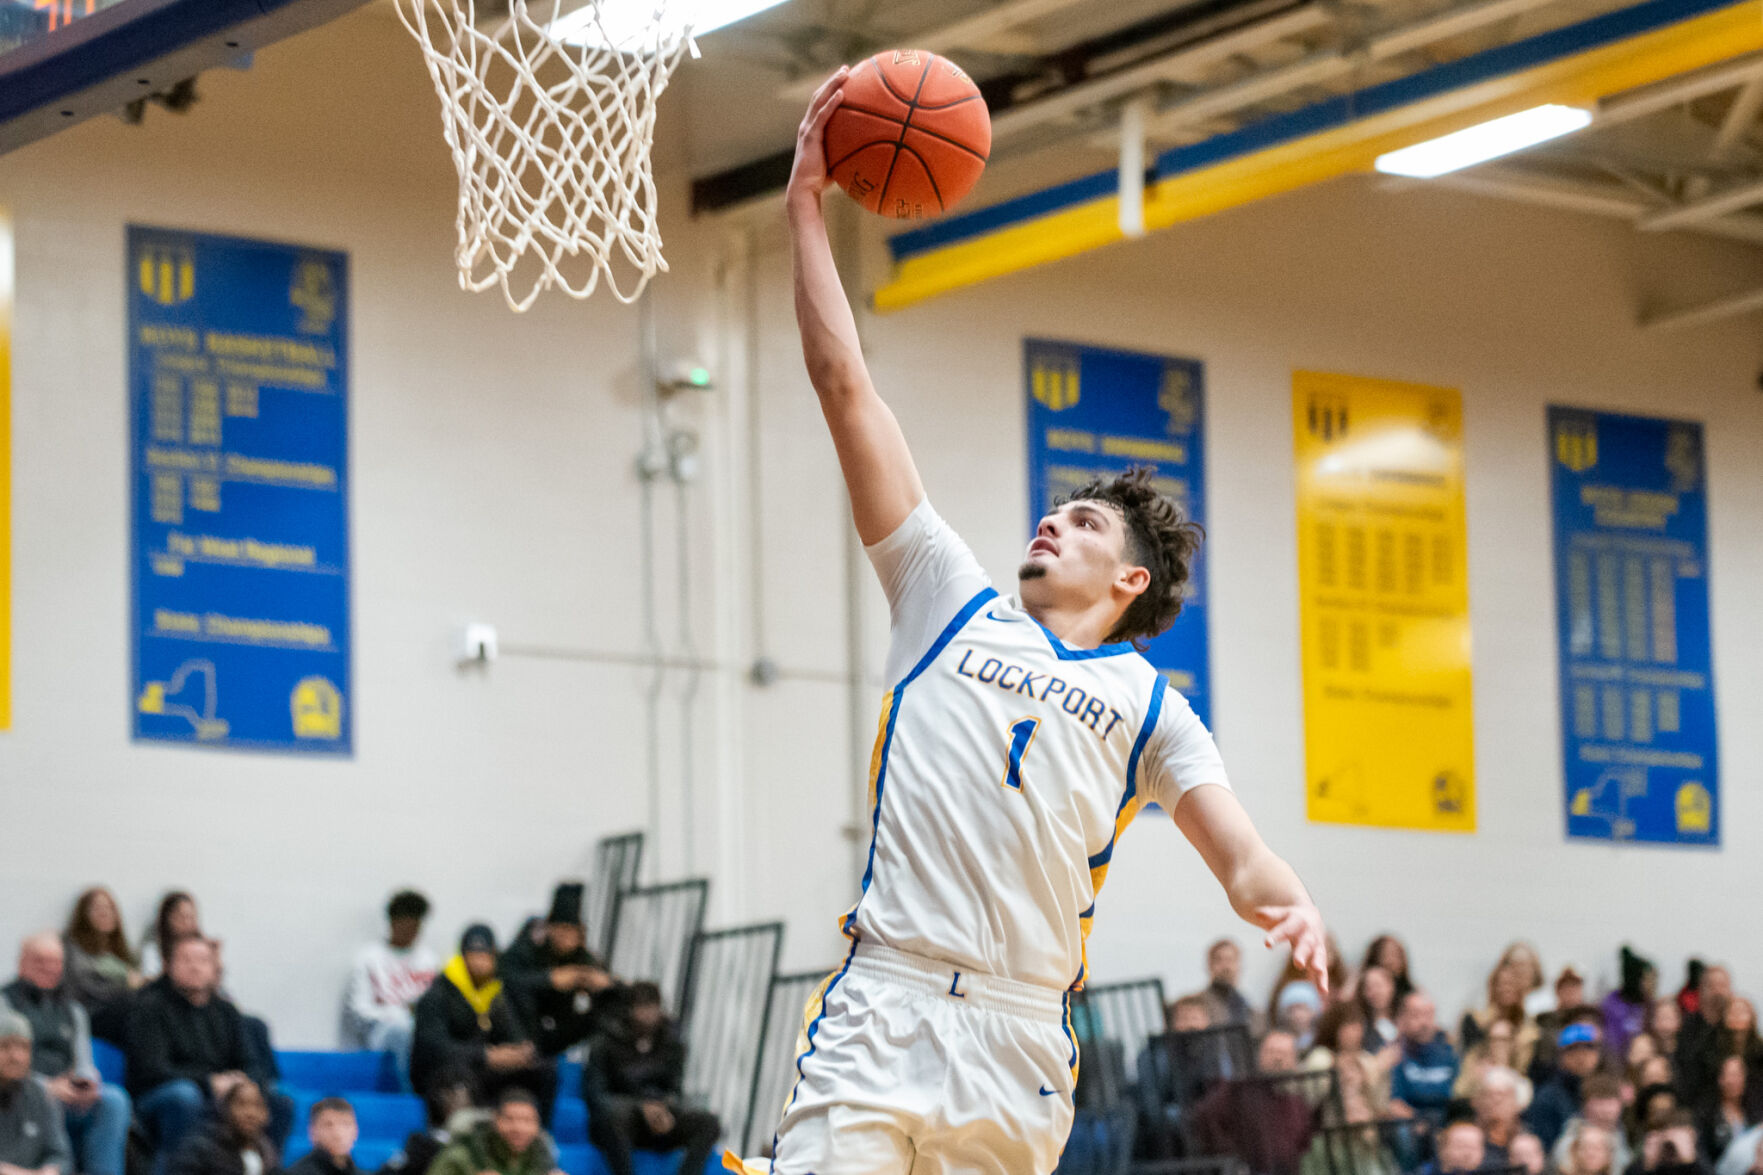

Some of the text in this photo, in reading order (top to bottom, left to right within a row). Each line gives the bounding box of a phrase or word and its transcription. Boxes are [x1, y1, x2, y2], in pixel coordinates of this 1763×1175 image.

[957, 649, 1124, 741] LOCKPORT
[1001, 715, 1042, 793] 1
[948, 971, 965, 998] L
